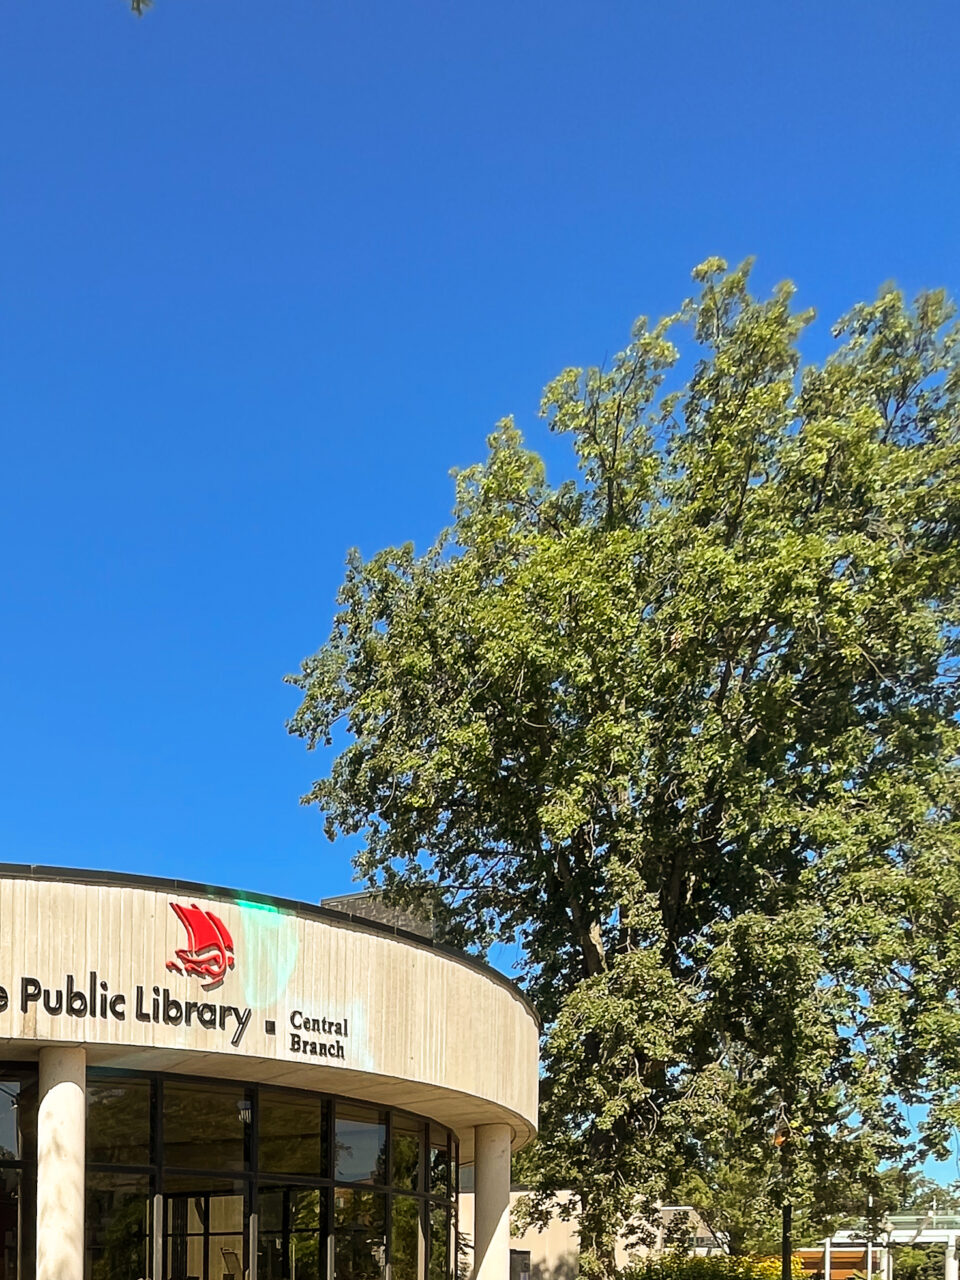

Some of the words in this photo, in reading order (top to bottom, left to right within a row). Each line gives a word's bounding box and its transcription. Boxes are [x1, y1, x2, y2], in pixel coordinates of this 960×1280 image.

[21, 971, 126, 1020] Public
[136, 985, 251, 1046] Library
[290, 1011, 348, 1037] Central
[290, 1034, 345, 1059] Branch
